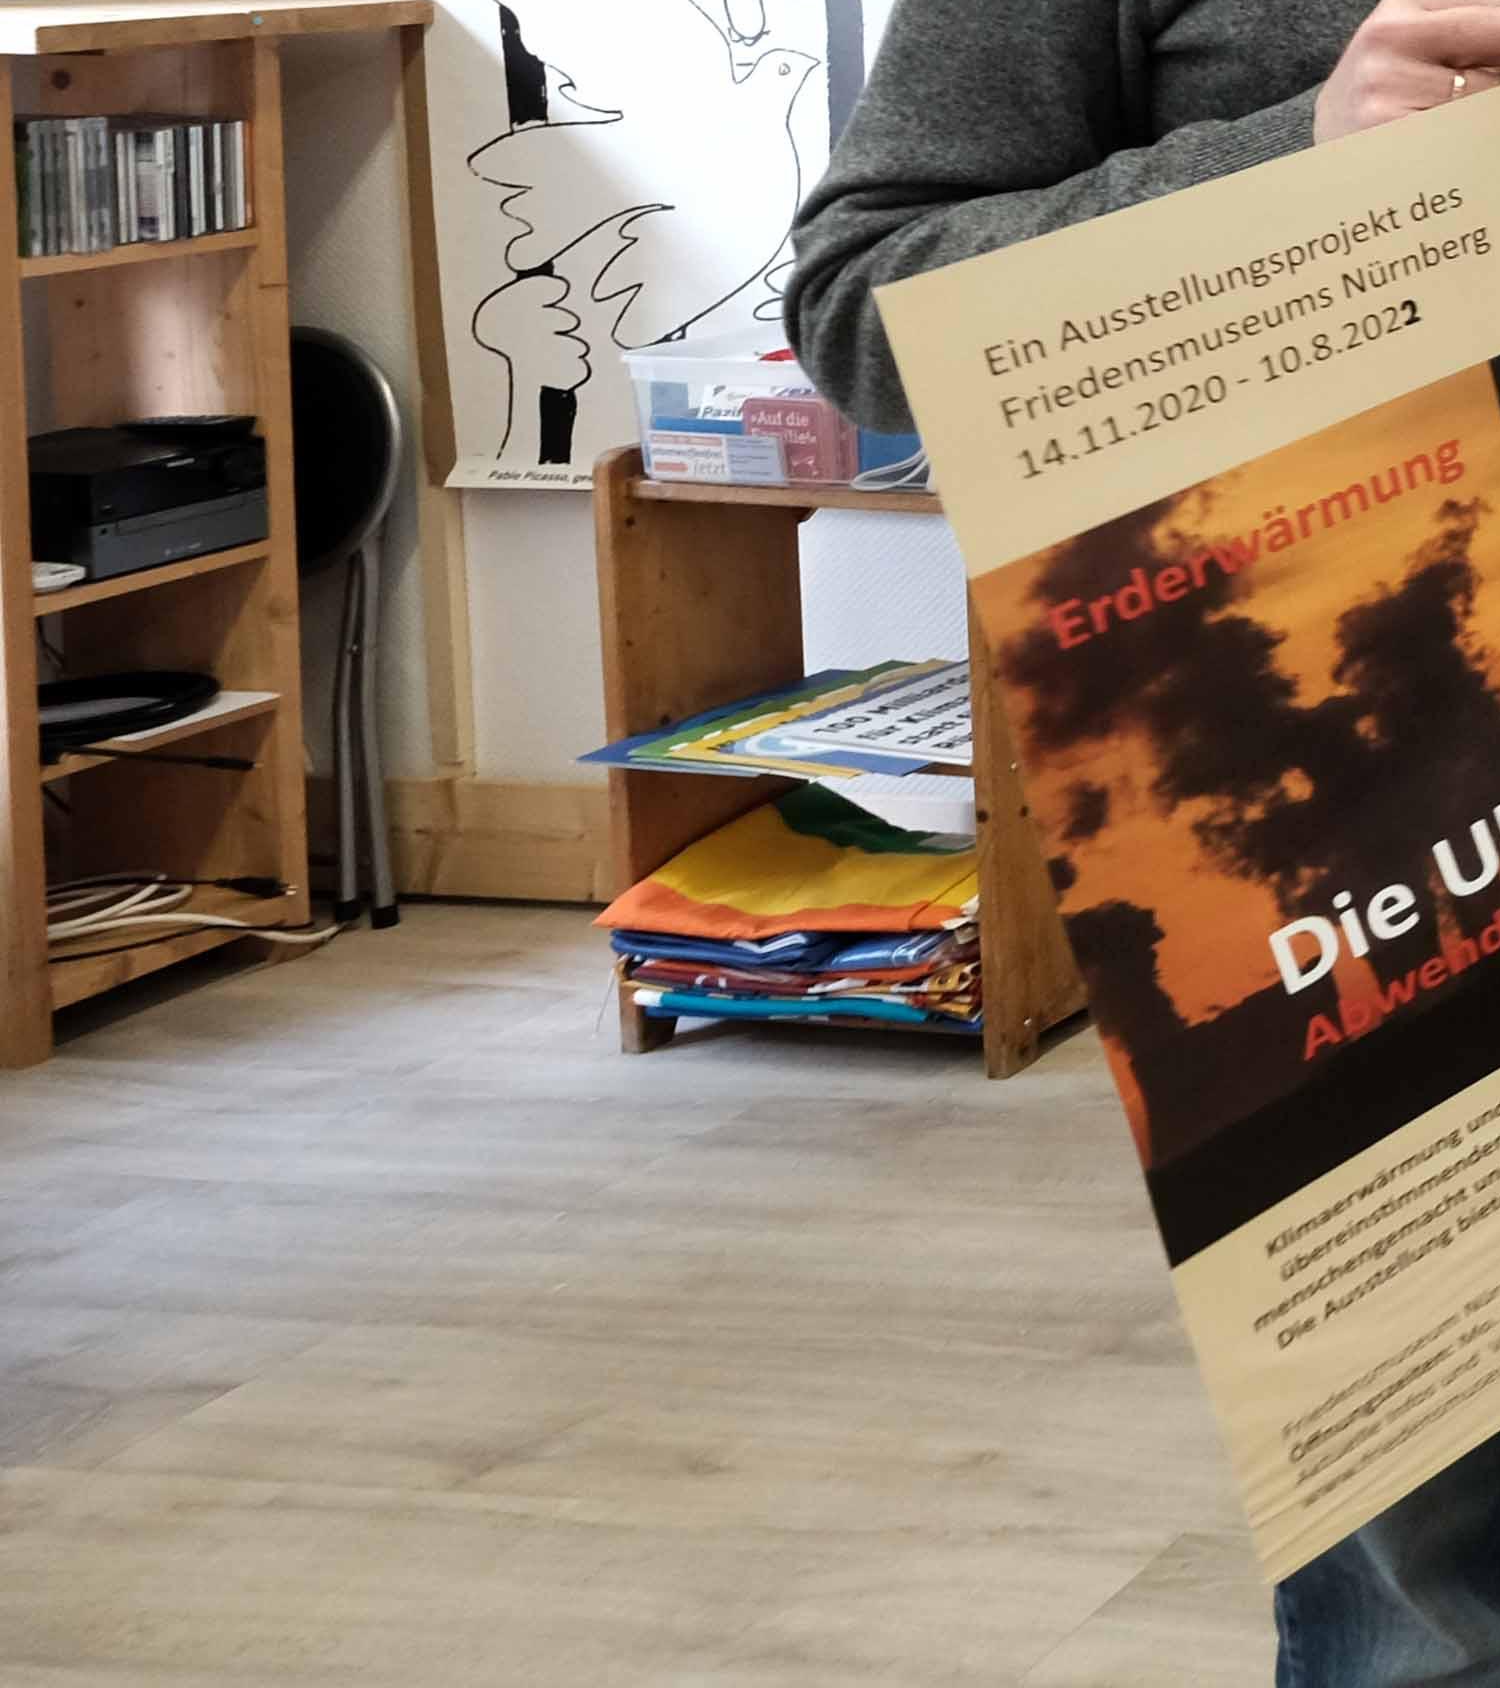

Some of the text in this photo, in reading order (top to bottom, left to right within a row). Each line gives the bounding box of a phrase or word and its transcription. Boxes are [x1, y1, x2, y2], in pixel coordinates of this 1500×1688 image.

[981, 185, 1466, 379] Ein Ausstellungsprojekt des
[999, 221, 1492, 431] Friedensmuseums Nürnberg
[1046, 434, 1465, 652] Erderwärmung
[1266, 877, 1424, 996] Die
